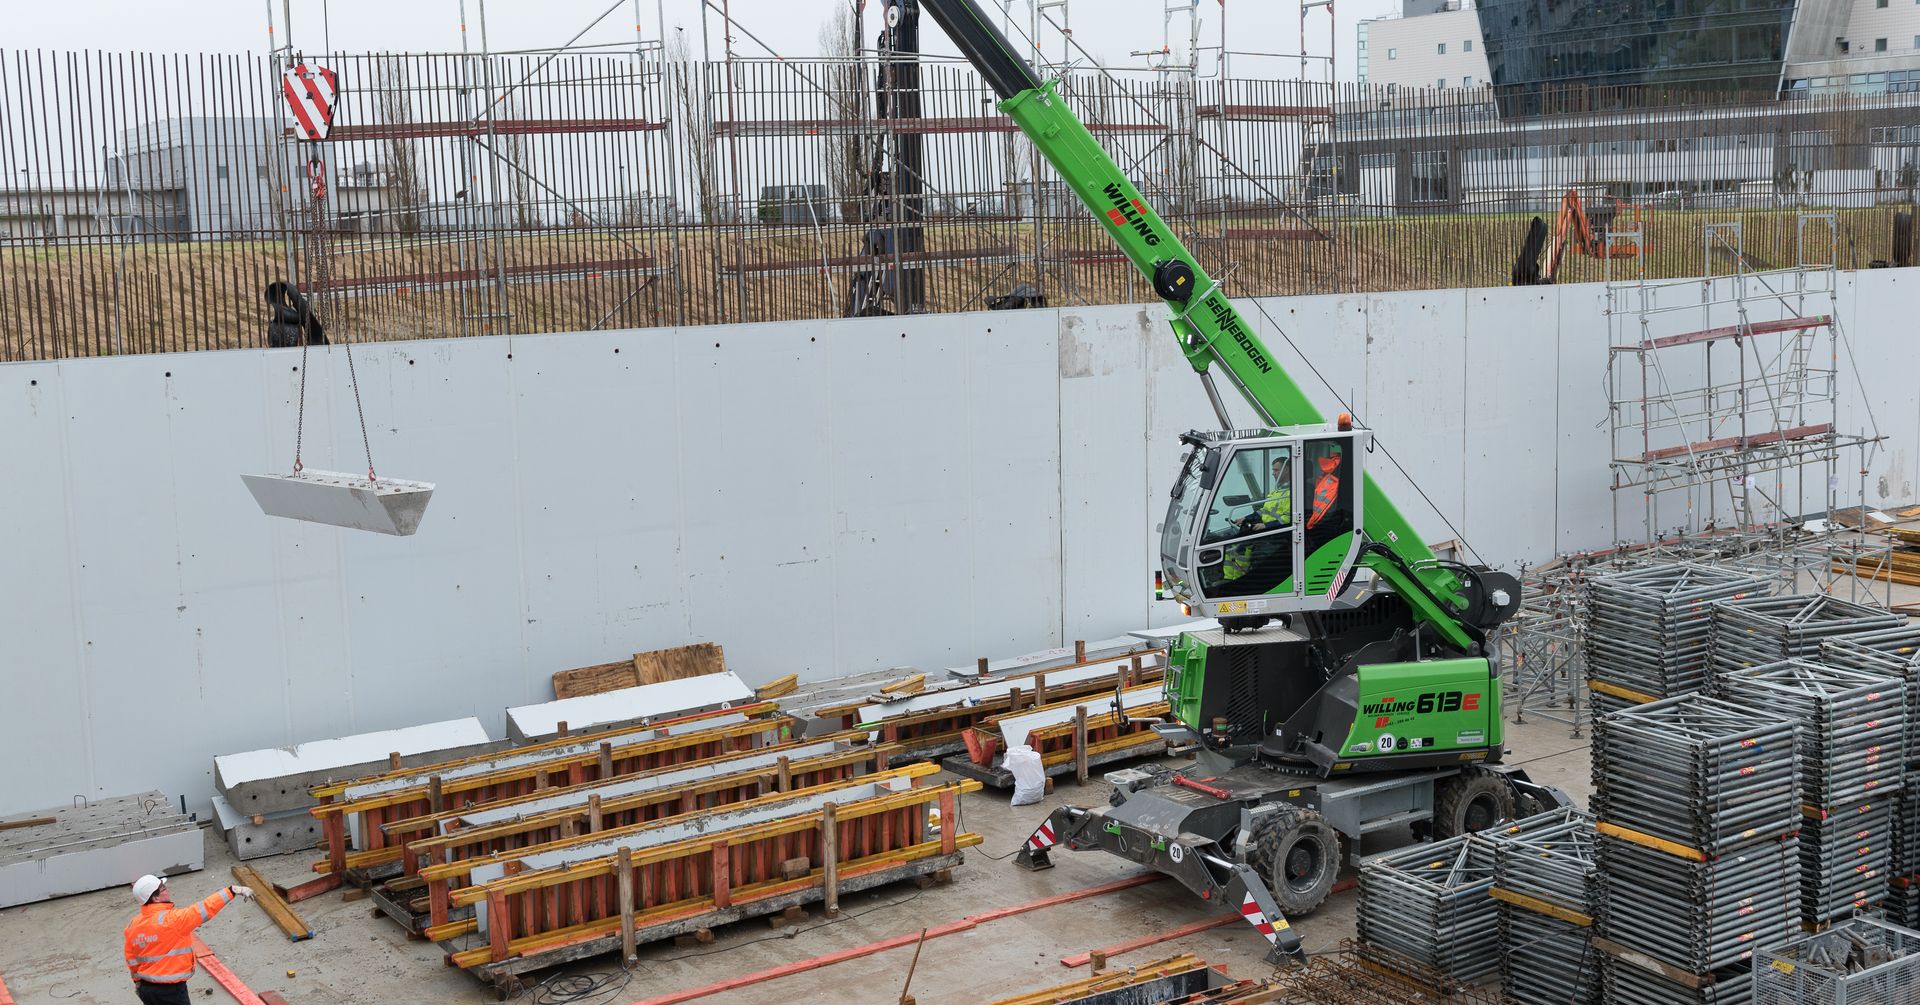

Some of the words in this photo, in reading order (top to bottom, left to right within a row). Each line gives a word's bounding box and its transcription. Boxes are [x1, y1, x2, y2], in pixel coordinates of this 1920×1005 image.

[1103, 183, 1160, 246] WILLING
[1205, 296, 1272, 374] SENNEBOGEN
[1363, 701, 1416, 714] WILLING
[1417, 691, 1480, 713] 613E
[1381, 737, 1392, 748] 20
[1172, 847, 1180, 858] 20
